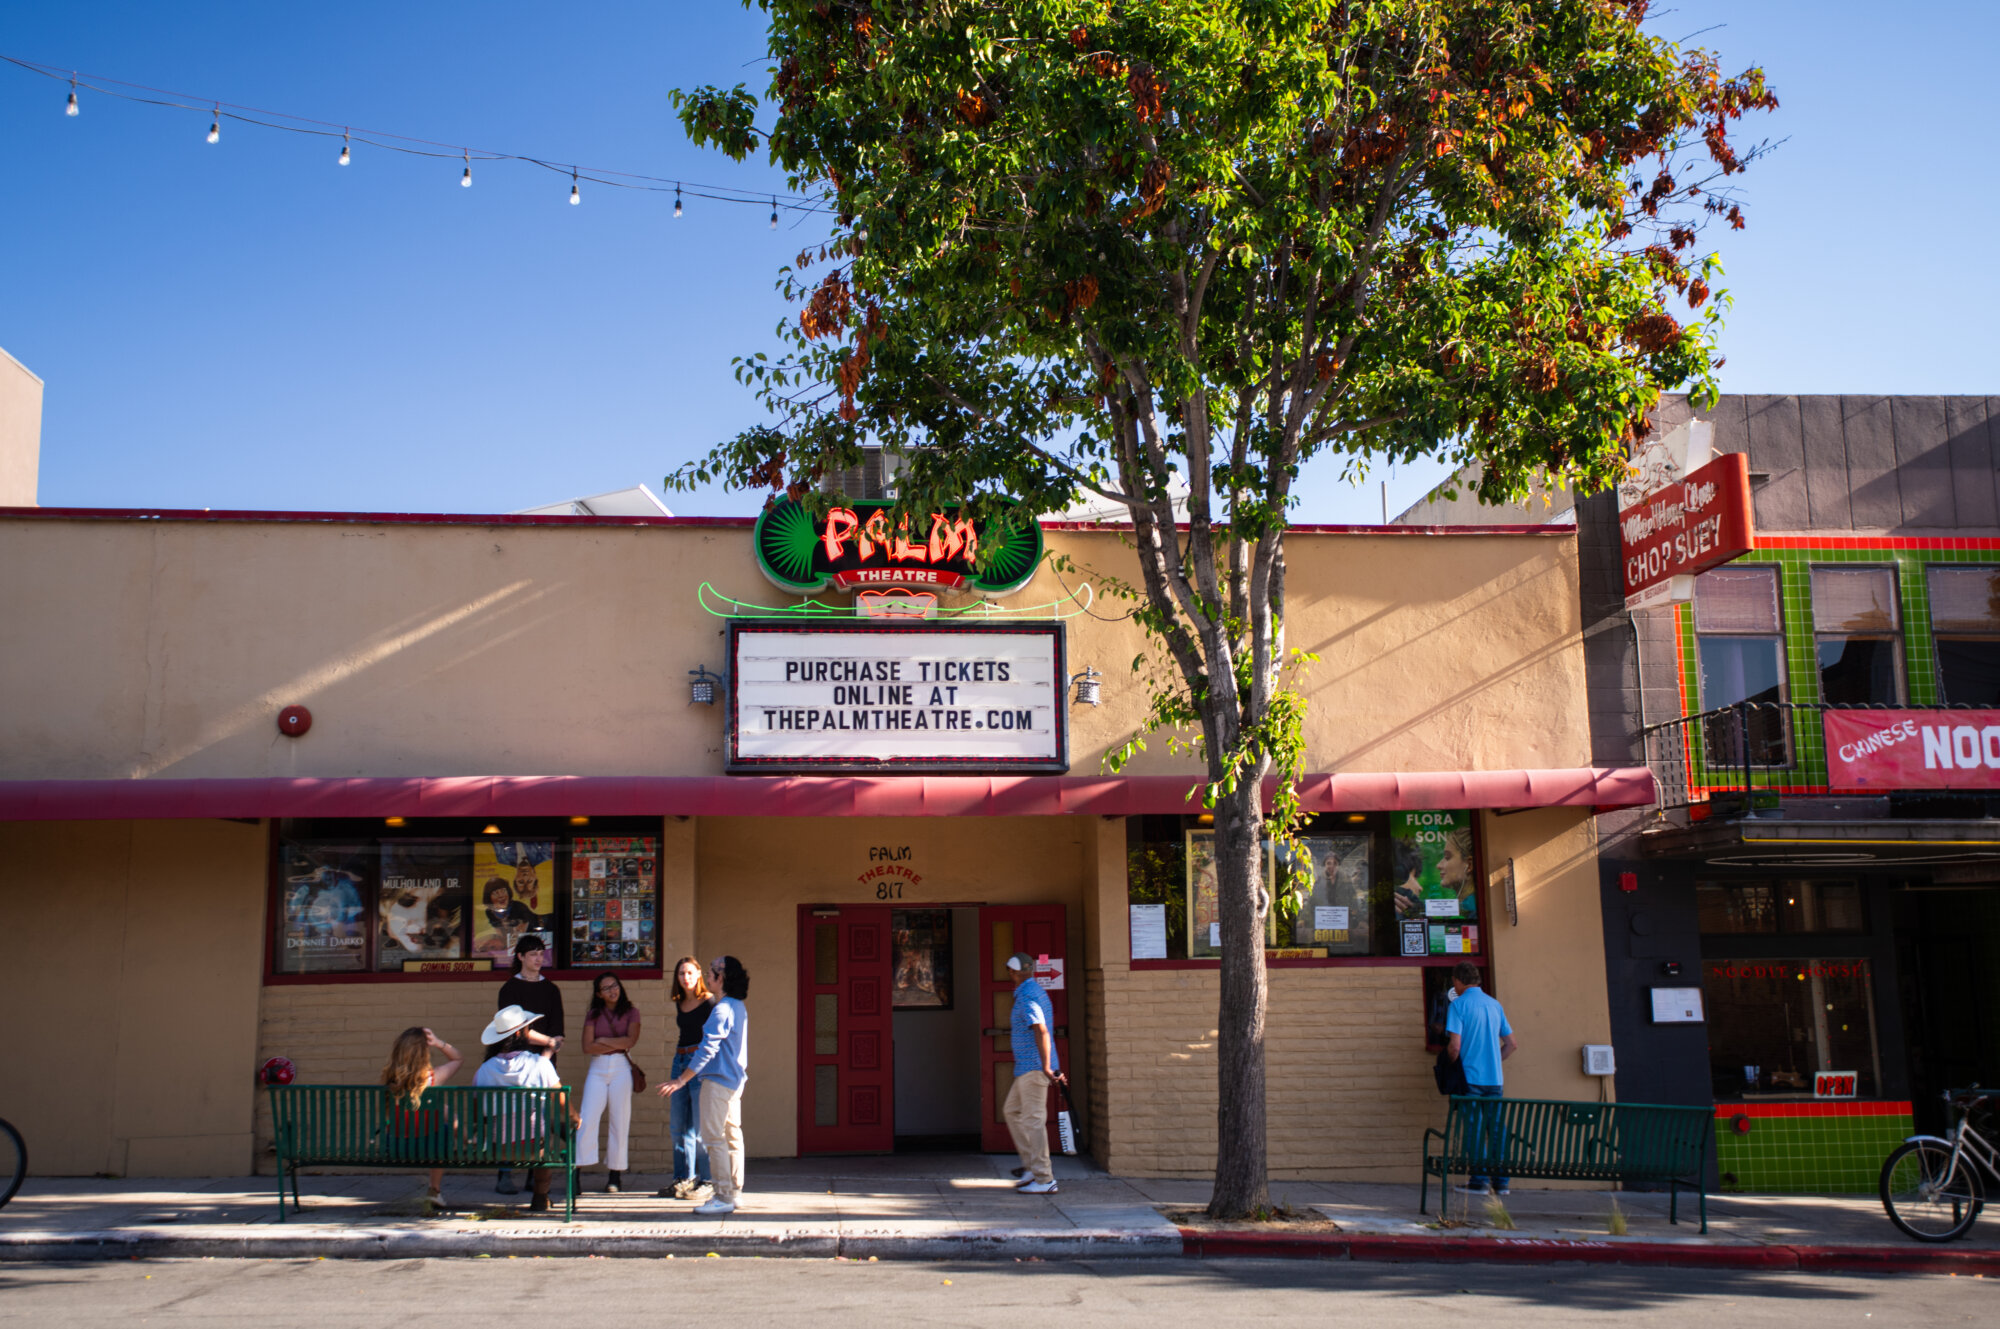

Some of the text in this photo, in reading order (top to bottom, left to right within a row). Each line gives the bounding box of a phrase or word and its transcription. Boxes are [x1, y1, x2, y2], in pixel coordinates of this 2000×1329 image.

[820, 507, 978, 564] PALM
[1628, 514, 1722, 587] CHOP SUEY
[857, 570, 938, 582] THEATRE
[786, 661, 1010, 682] PURCHASE TICKETS
[833, 685, 958, 706] ONLINE AT
[764, 710, 1033, 730] THEPALMTHEATRE.COM
[1839, 719, 1919, 763] CHINESE
[1406, 813, 1454, 826] FLORA
[1415, 831, 1448, 843] SON
[869, 846, 912, 862] PALM
[383, 878, 461, 889] MULHOLLAND DR.
[857, 865, 923, 886] THEATRE
[876, 882, 904, 900] 817
[287, 937, 364, 948] DONNIE DARKO
[1315, 929, 1349, 942] GOLDA
[421, 962, 475, 971] COMING SOON
[1712, 964, 1863, 979] NOODLE HOUSE
[1816, 1075, 1855, 1096] OPEN
[1496, 1239, 1614, 1248] FIRE LANE
